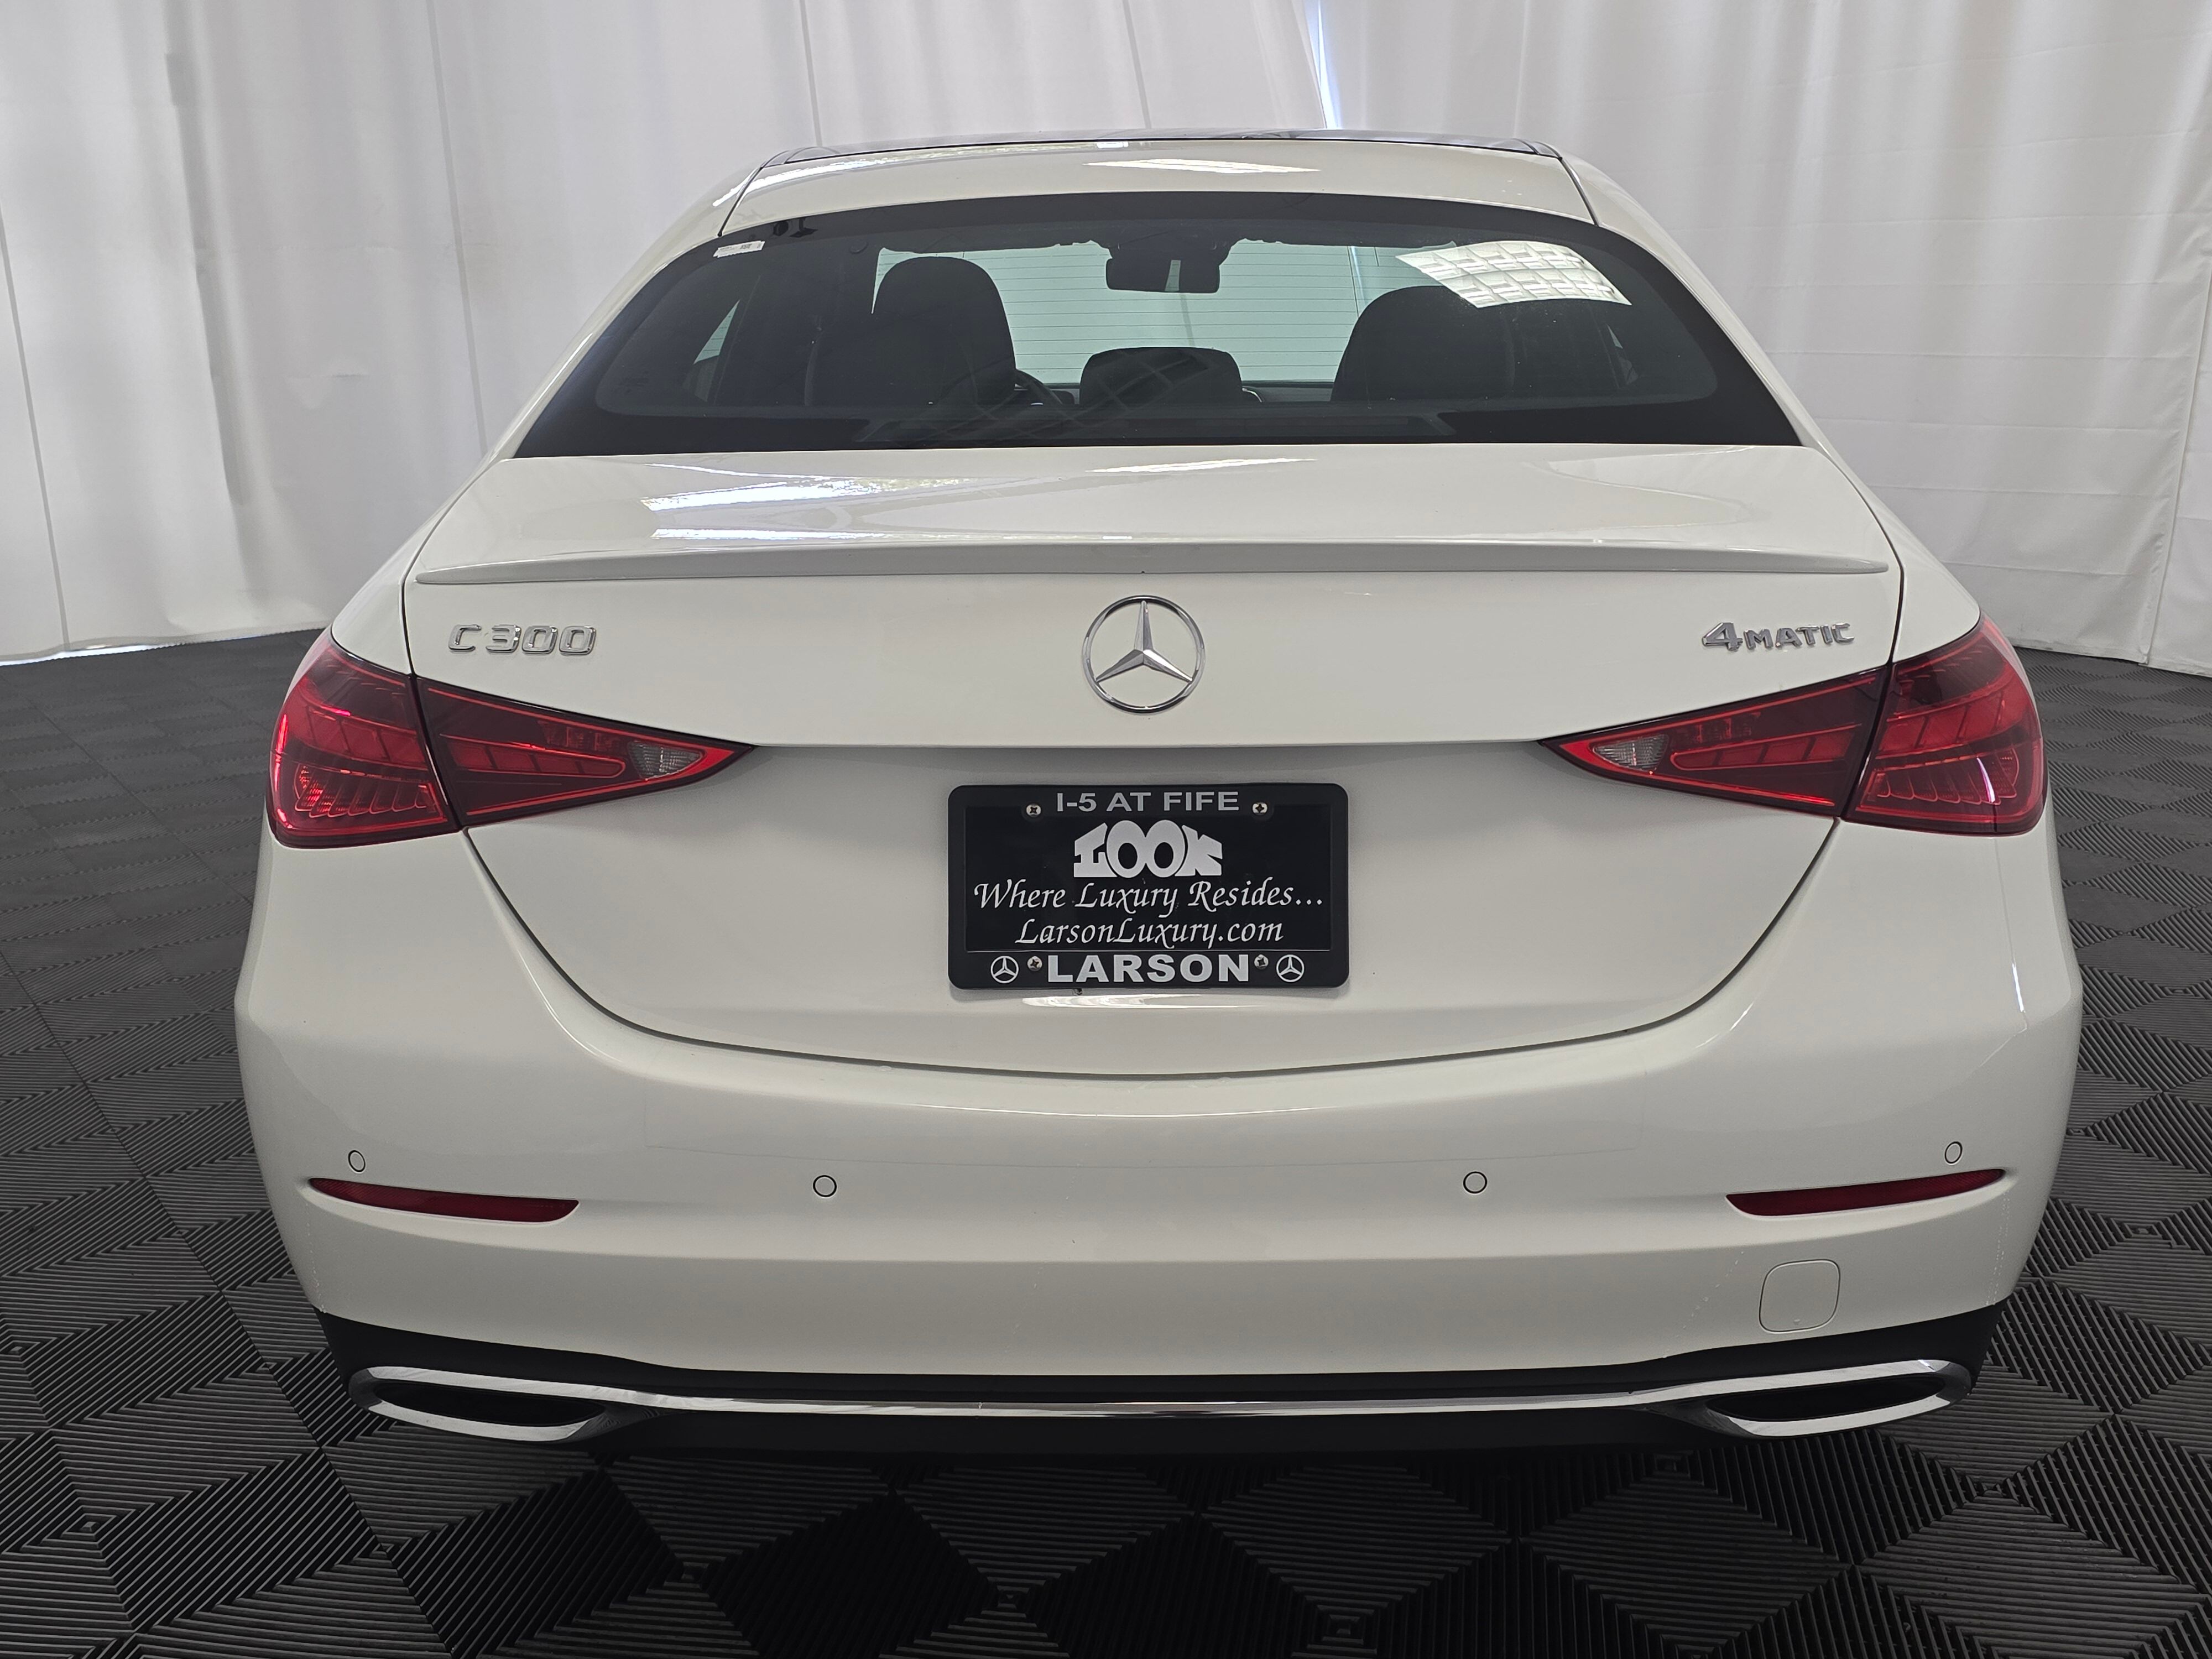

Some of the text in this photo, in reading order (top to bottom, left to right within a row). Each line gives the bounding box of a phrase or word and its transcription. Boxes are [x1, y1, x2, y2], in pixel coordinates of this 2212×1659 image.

[1702, 622, 1854, 651] 4MATIC
[1057, 791, 1239, 812] I-5 AT FIFE
[974, 877, 1323, 918] Where Luxury Resides...
[1015, 919, 1284, 949] LarsonLuxury.com
[1048, 954, 1249, 983] LARSON
